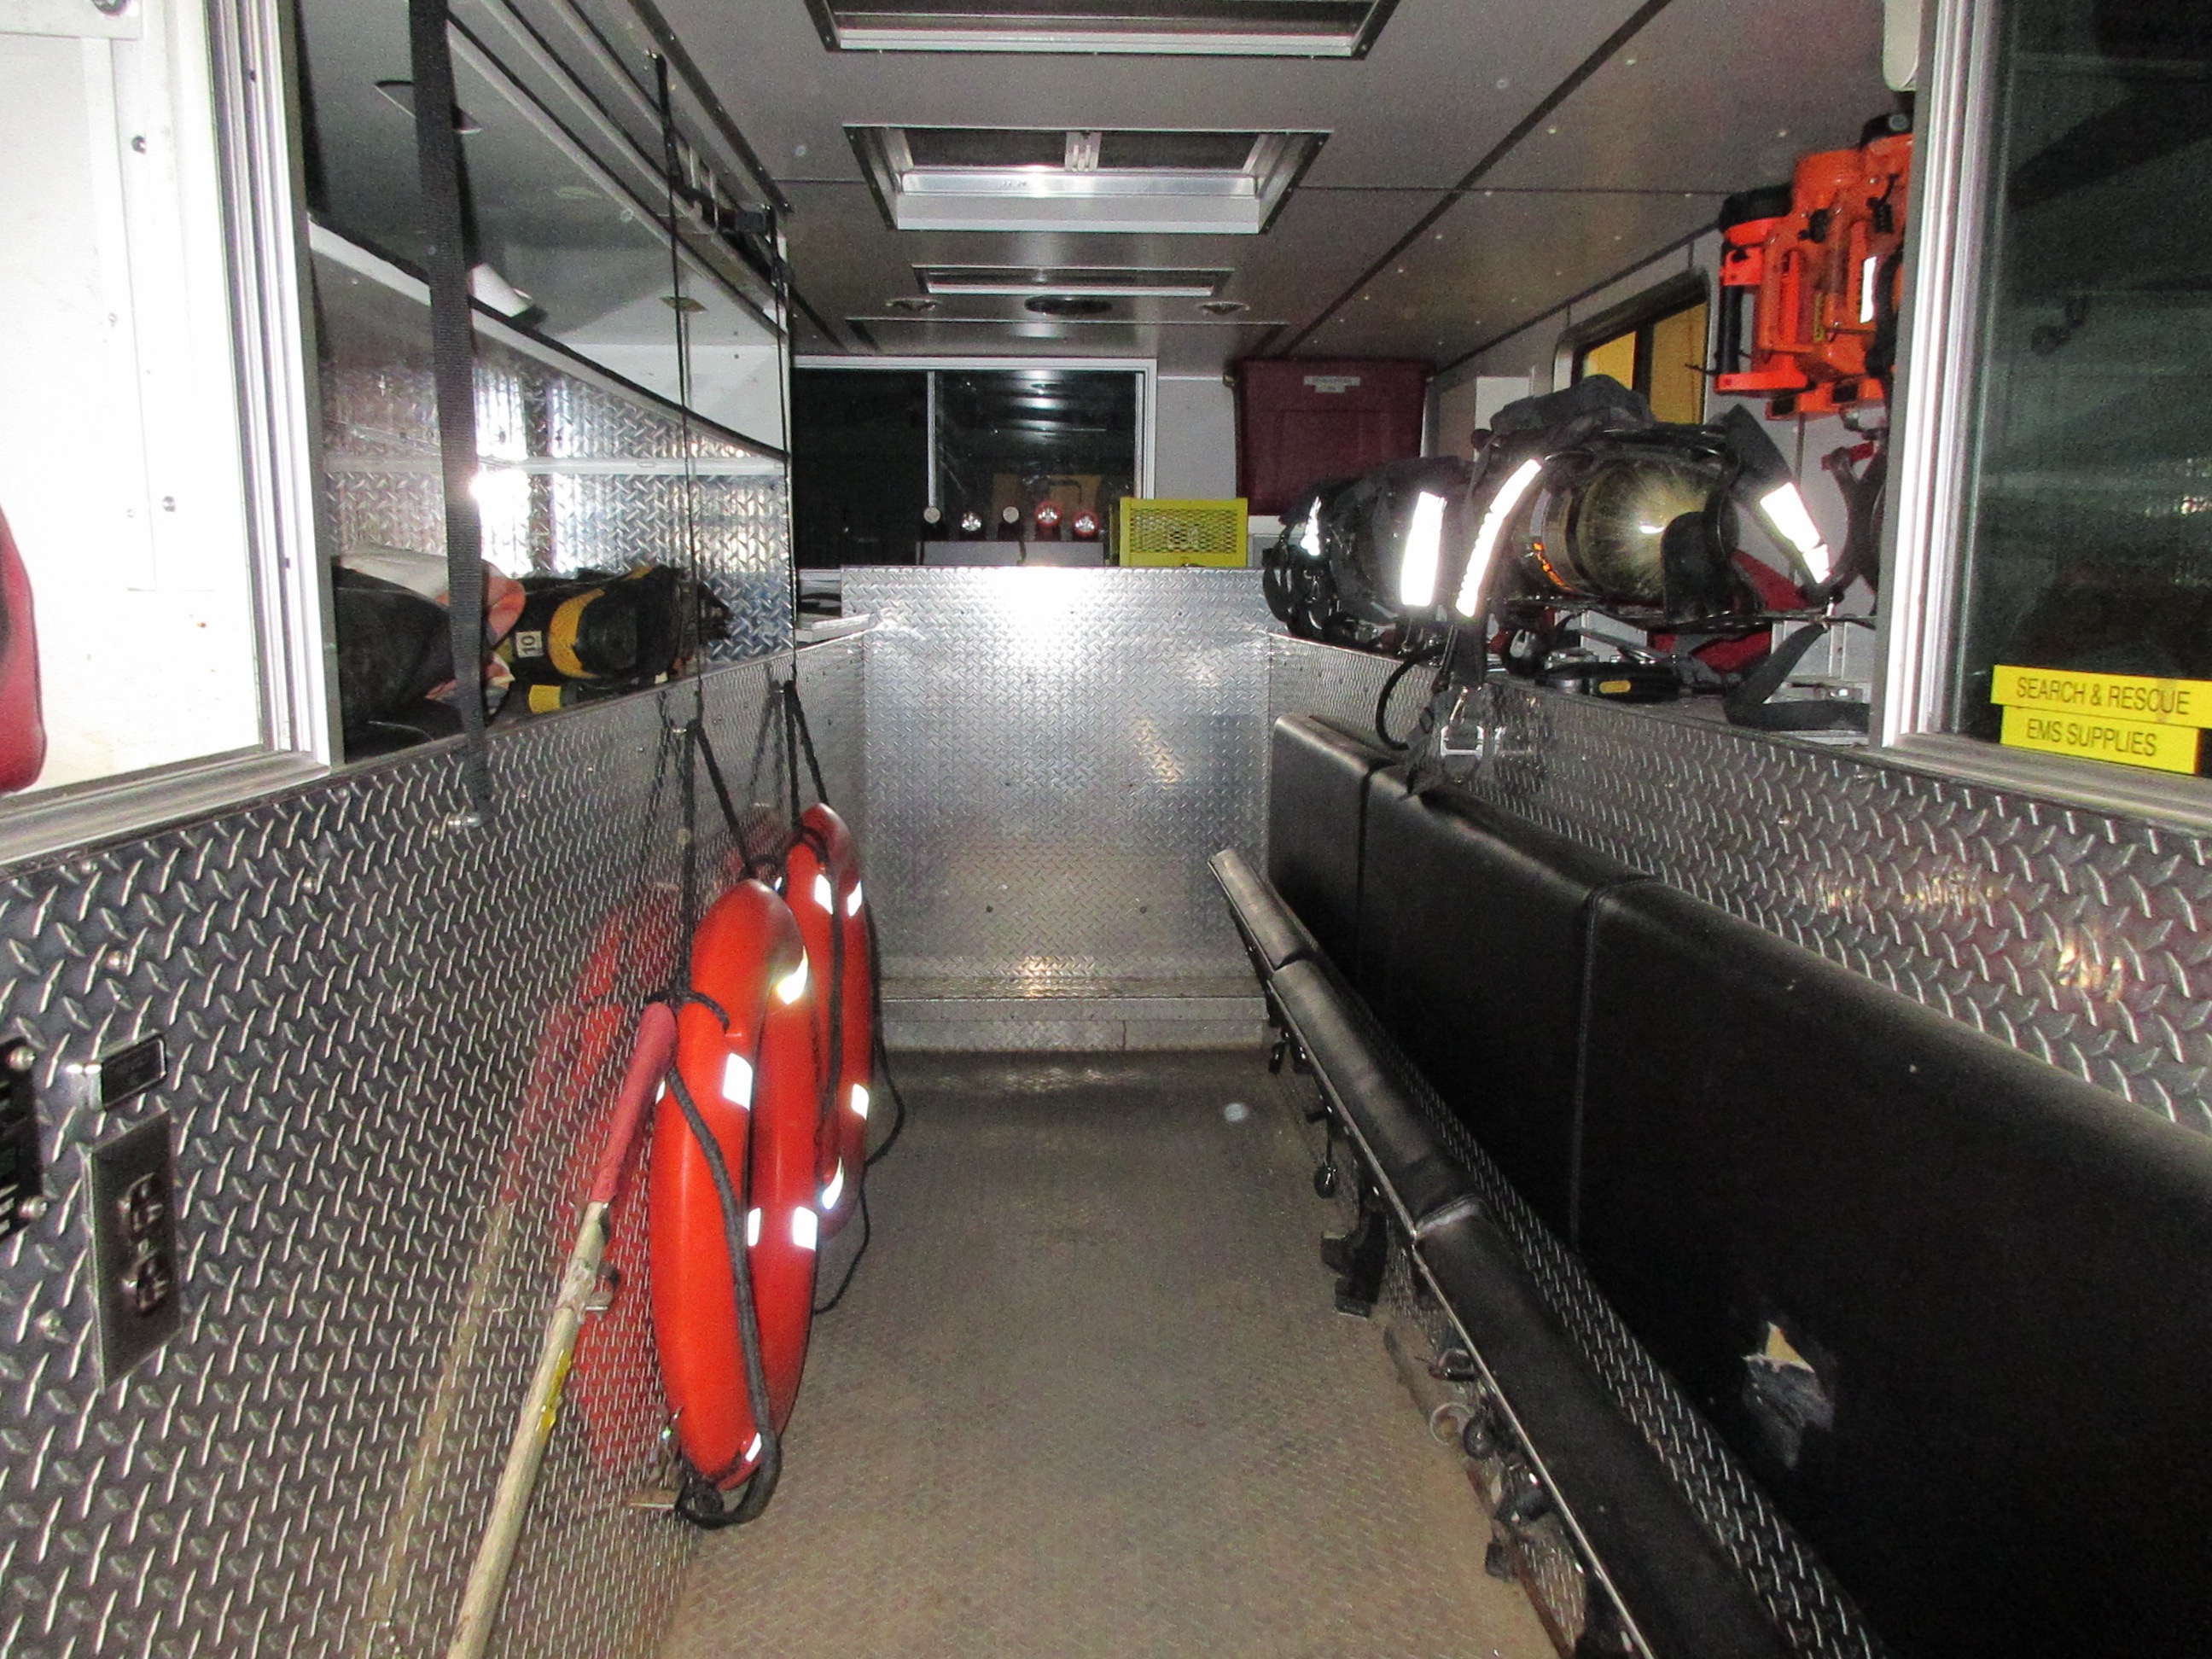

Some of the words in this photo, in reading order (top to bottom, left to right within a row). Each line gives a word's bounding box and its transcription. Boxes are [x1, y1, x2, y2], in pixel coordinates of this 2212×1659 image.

[521, 635, 535, 654] 10
[2017, 677, 2086, 704] SEARCH
[2091, 684, 2102, 706] &
[2109, 685, 2191, 715] RESCUE
[2026, 719, 2062, 743] EMS
[2066, 723, 2157, 757] SUPPLIES
